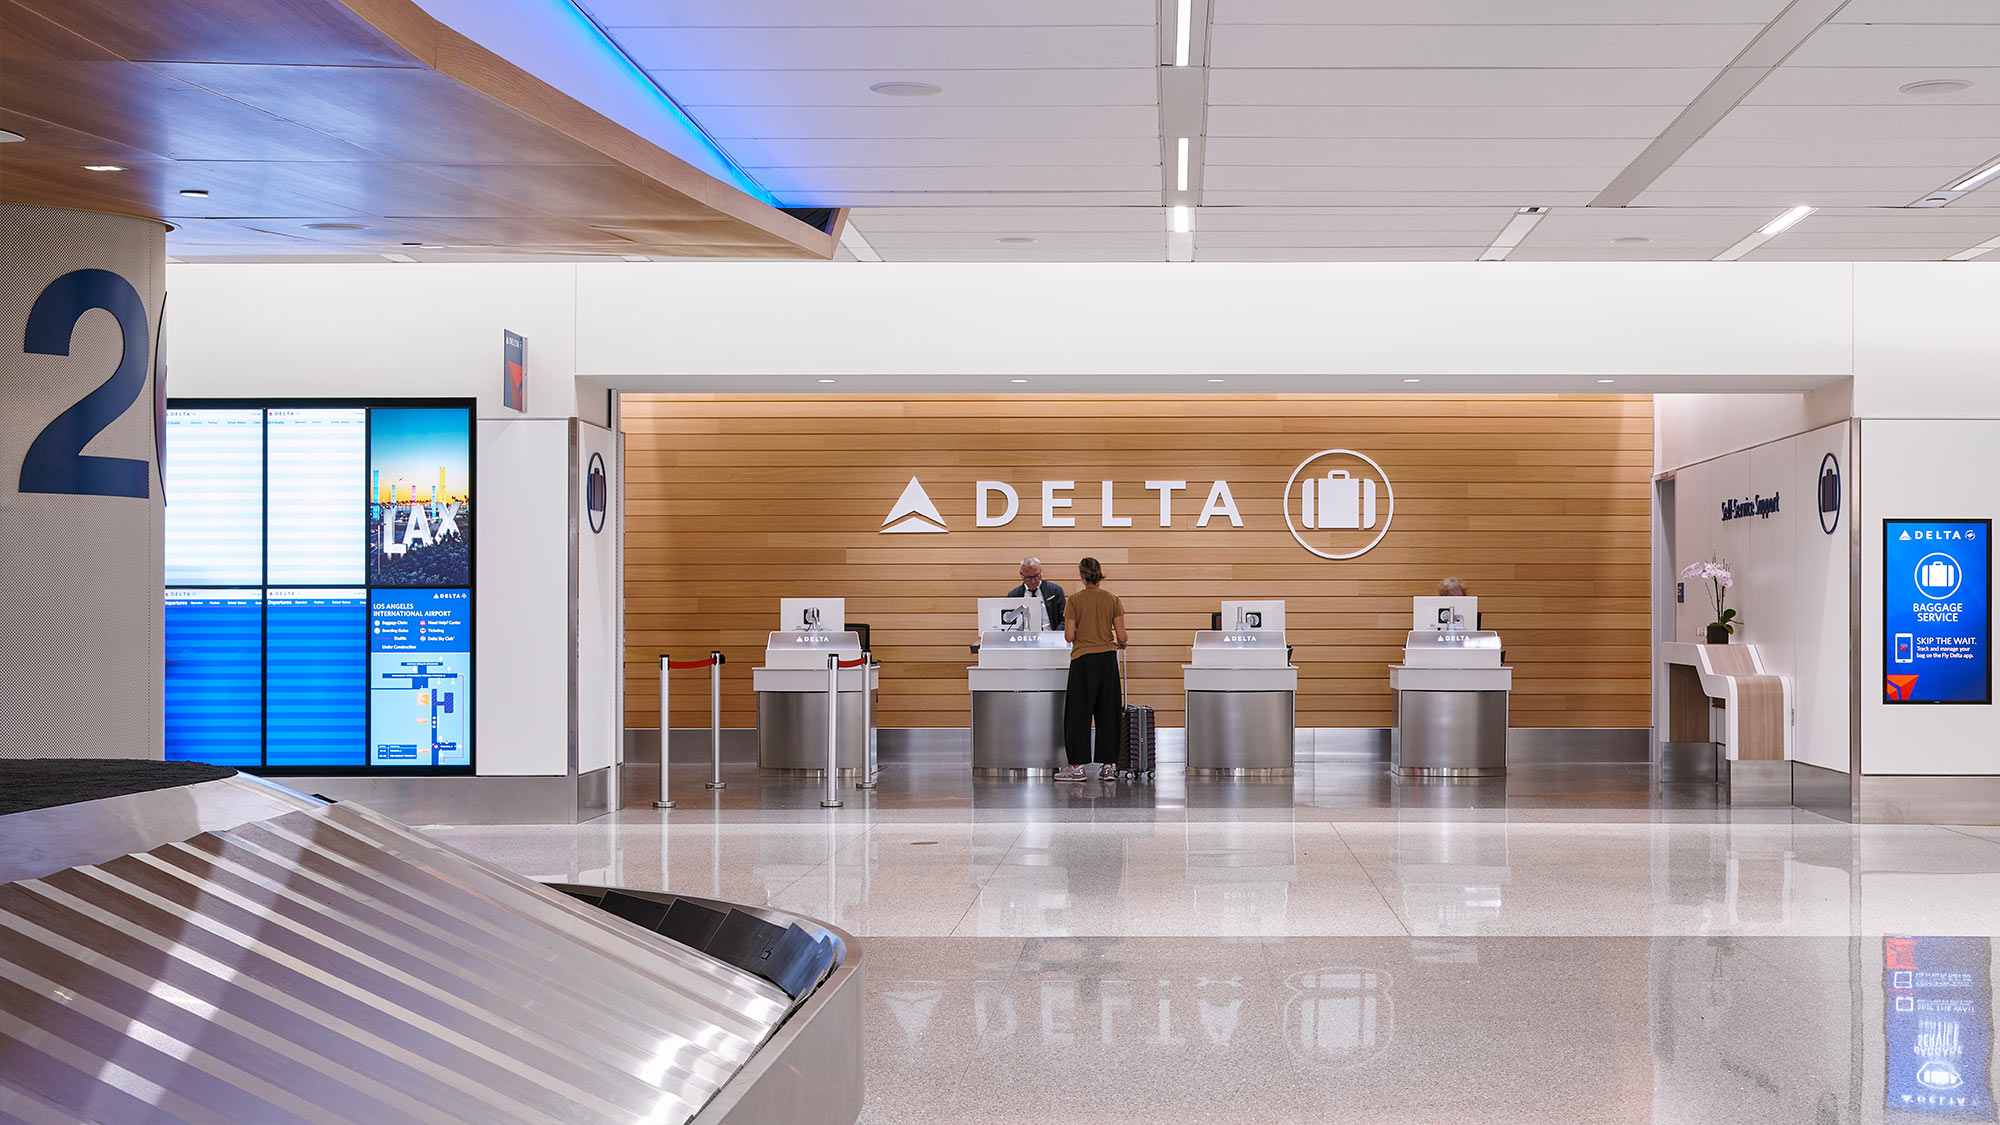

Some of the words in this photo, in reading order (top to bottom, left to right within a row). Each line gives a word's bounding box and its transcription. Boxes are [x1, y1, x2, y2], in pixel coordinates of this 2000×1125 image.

[18, 268, 150, 499] 2
[975, 480, 1245, 528] DELTA
[1755, 491, 1780, 519] Support
[383, 501, 461, 554] LAX
[1914, 530, 1962, 540] DELTA
[1913, 603, 1963, 612] BAGGAGE
[1917, 613, 1959, 622] SERVICE
[1916, 637, 1934, 645] SKIP
[1936, 637, 1952, 645] THE
[1953, 637, 1977, 645] WAIT.
